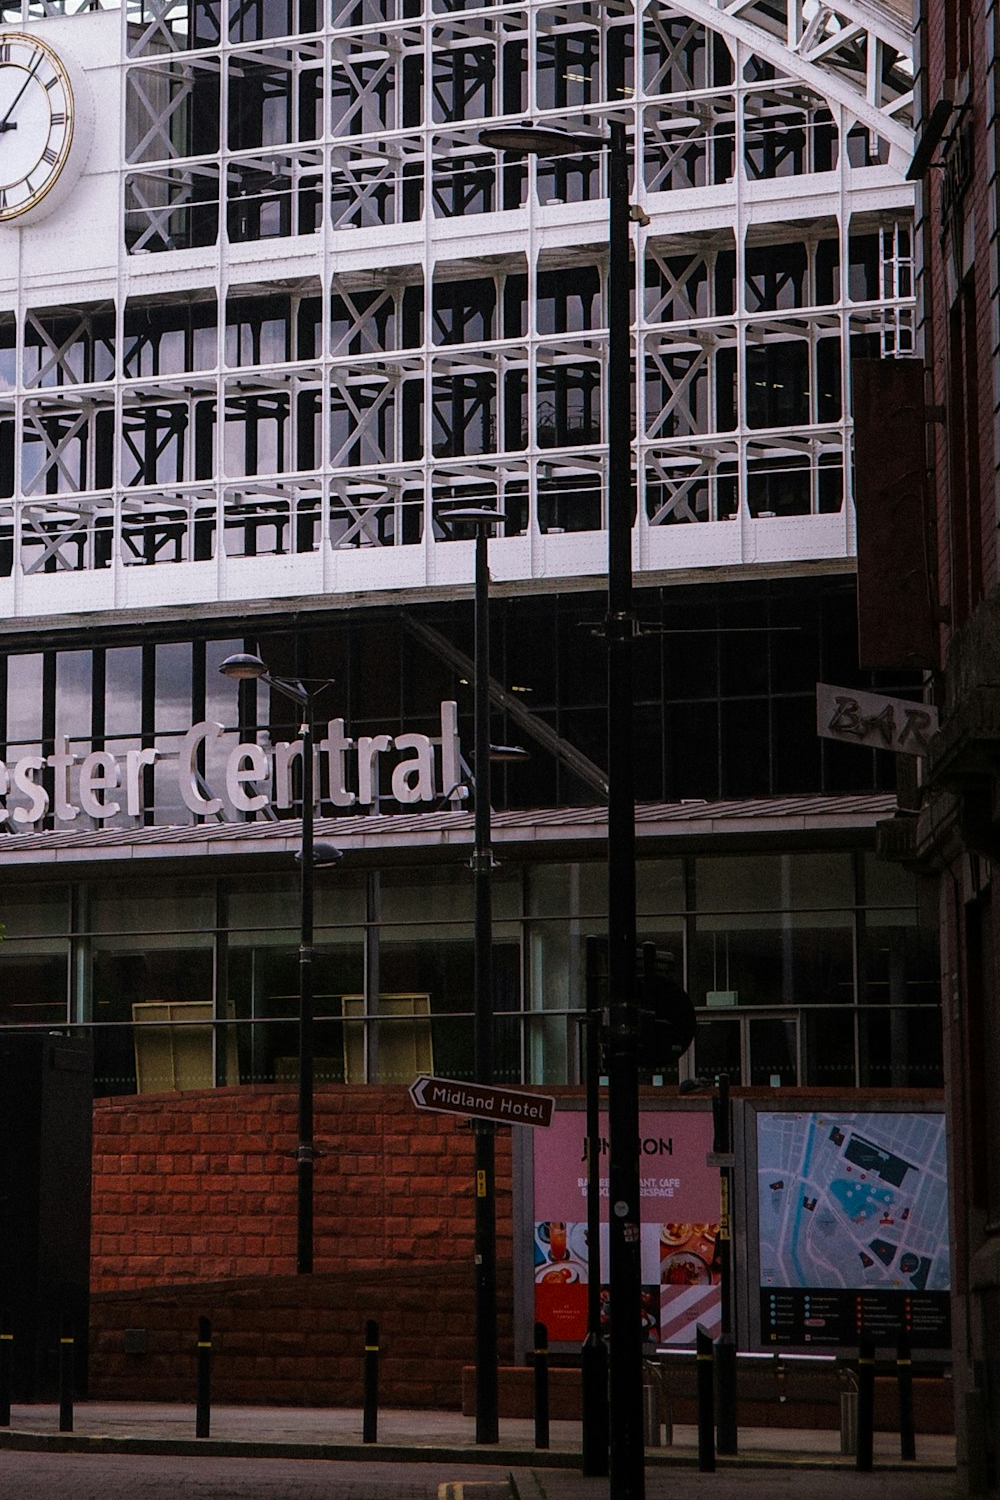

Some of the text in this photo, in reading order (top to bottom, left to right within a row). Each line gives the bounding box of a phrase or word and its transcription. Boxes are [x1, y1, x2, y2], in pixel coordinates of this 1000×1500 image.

[828, 696, 932, 748] BAR
[179, 701, 469, 816] Central
[432, 1087, 544, 1119] Midland Hotel
[659, 1178, 680, 1188] CAFE
